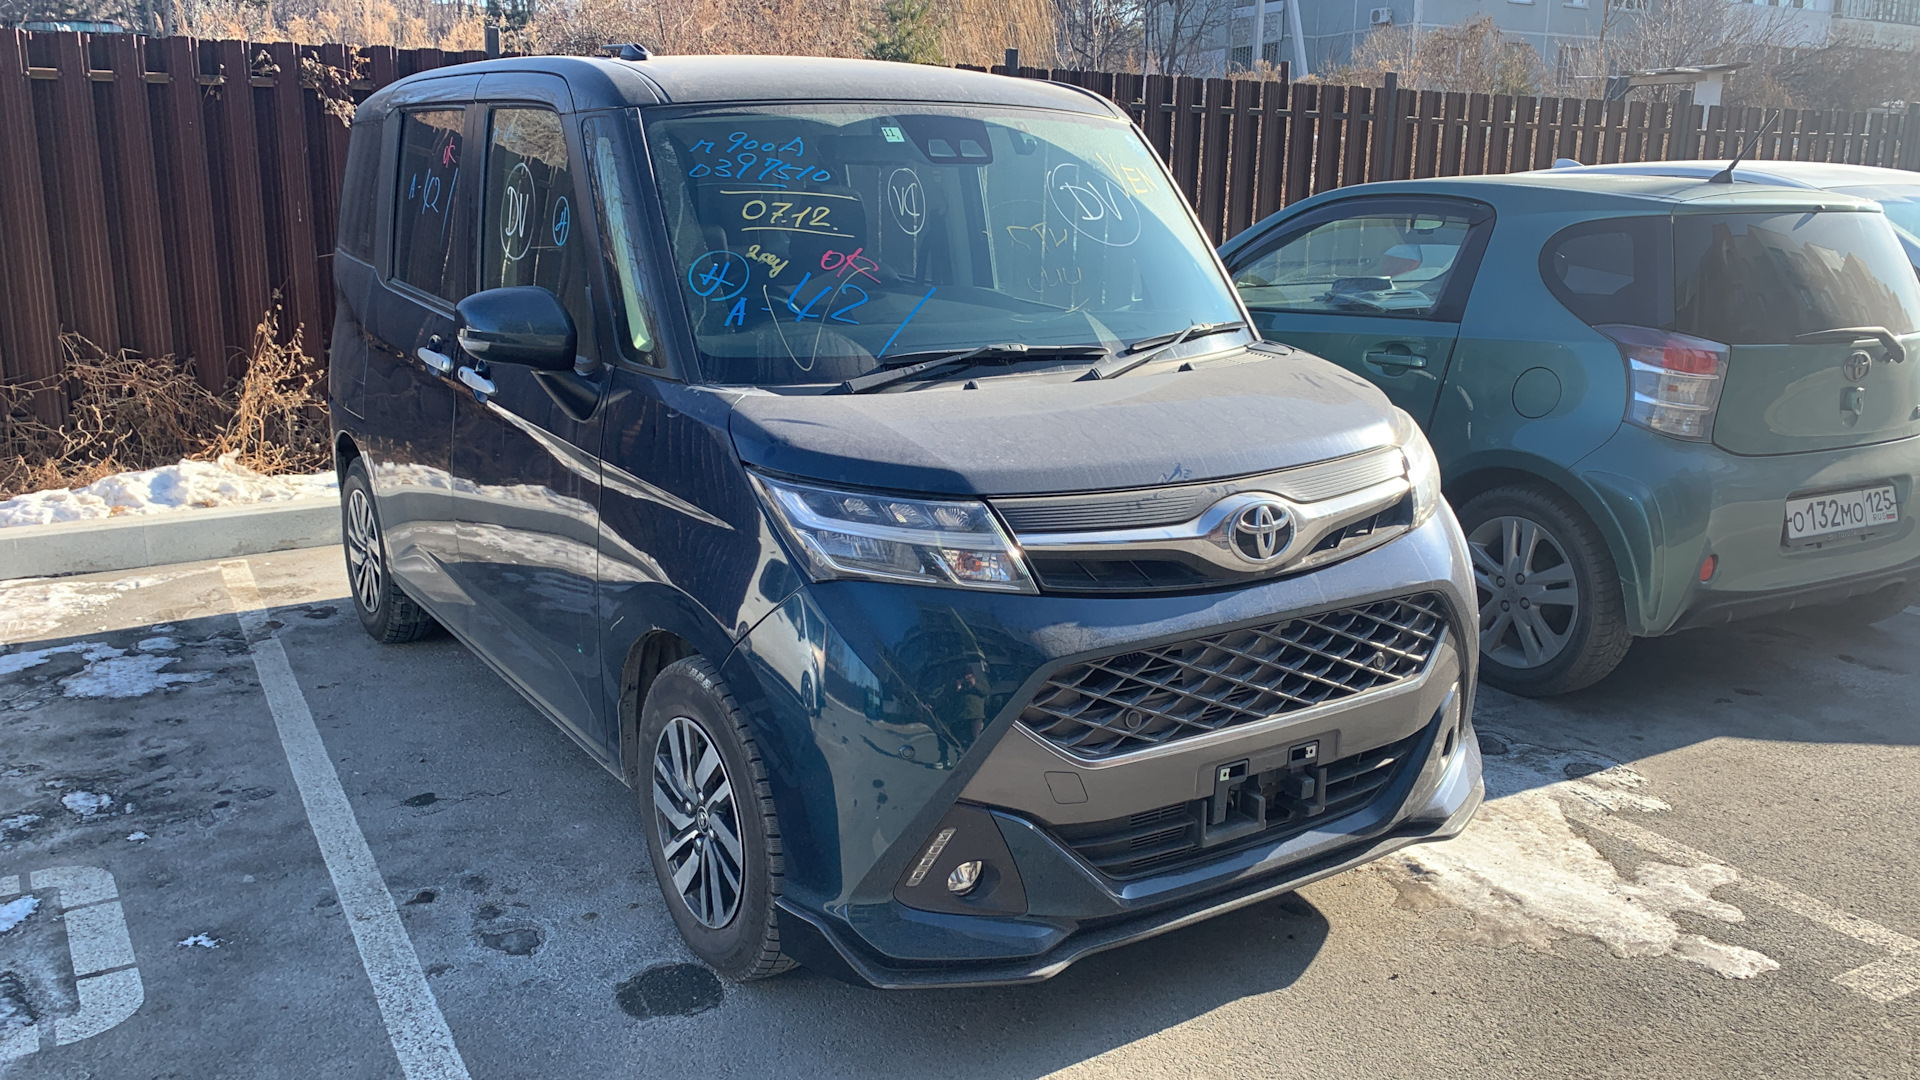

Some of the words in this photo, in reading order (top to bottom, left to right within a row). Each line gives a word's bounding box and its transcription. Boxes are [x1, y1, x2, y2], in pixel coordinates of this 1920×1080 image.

[688, 152, 831, 182] 0397510
[1793, 499, 1864, 533] O132MO
[1865, 489, 1892, 513] 125
[1872, 513, 1887, 521] RUS
